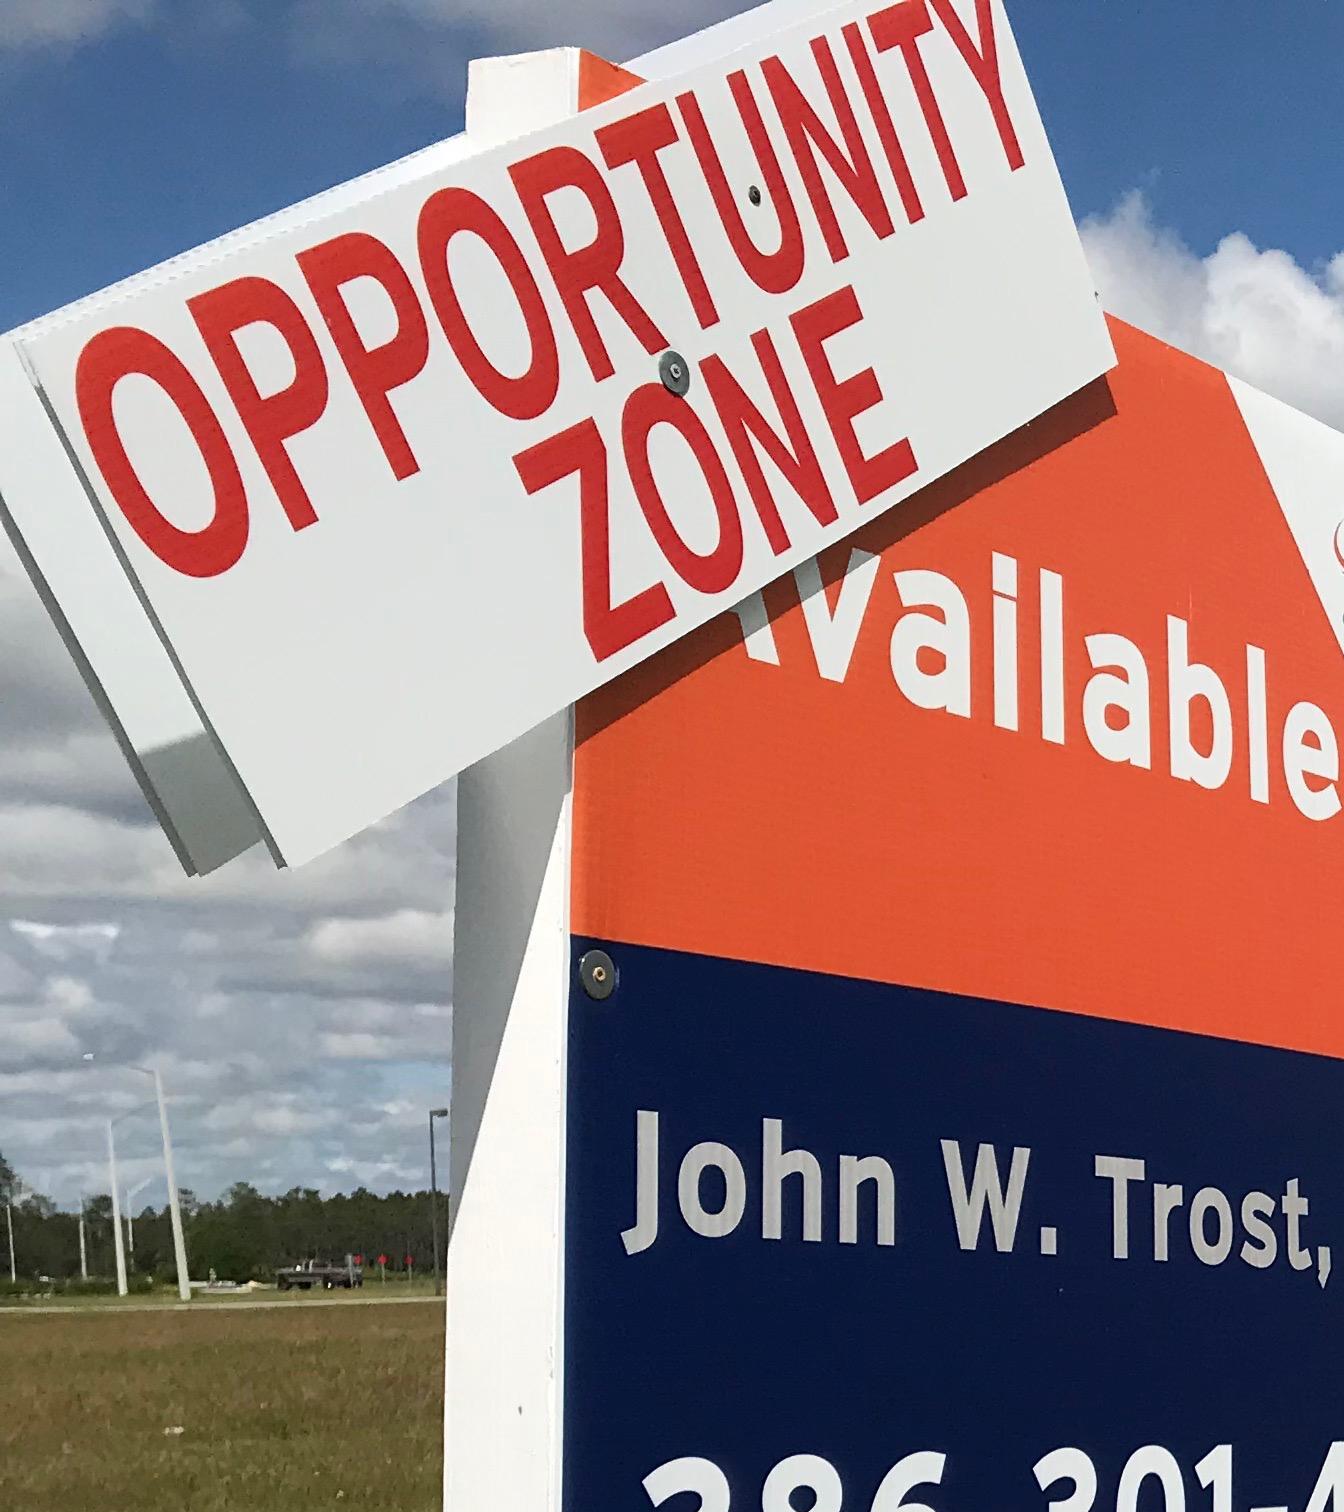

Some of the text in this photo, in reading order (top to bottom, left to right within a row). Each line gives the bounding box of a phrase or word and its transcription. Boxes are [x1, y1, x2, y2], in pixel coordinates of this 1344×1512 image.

[75, 0, 1026, 579] OPPORTUNITY
[512, 284, 919, 663] ZONE
[621, 1110, 895, 1255] John
[940, 1139, 1058, 1255] W.
[1094, 1155, 1332, 1288] Trost,
